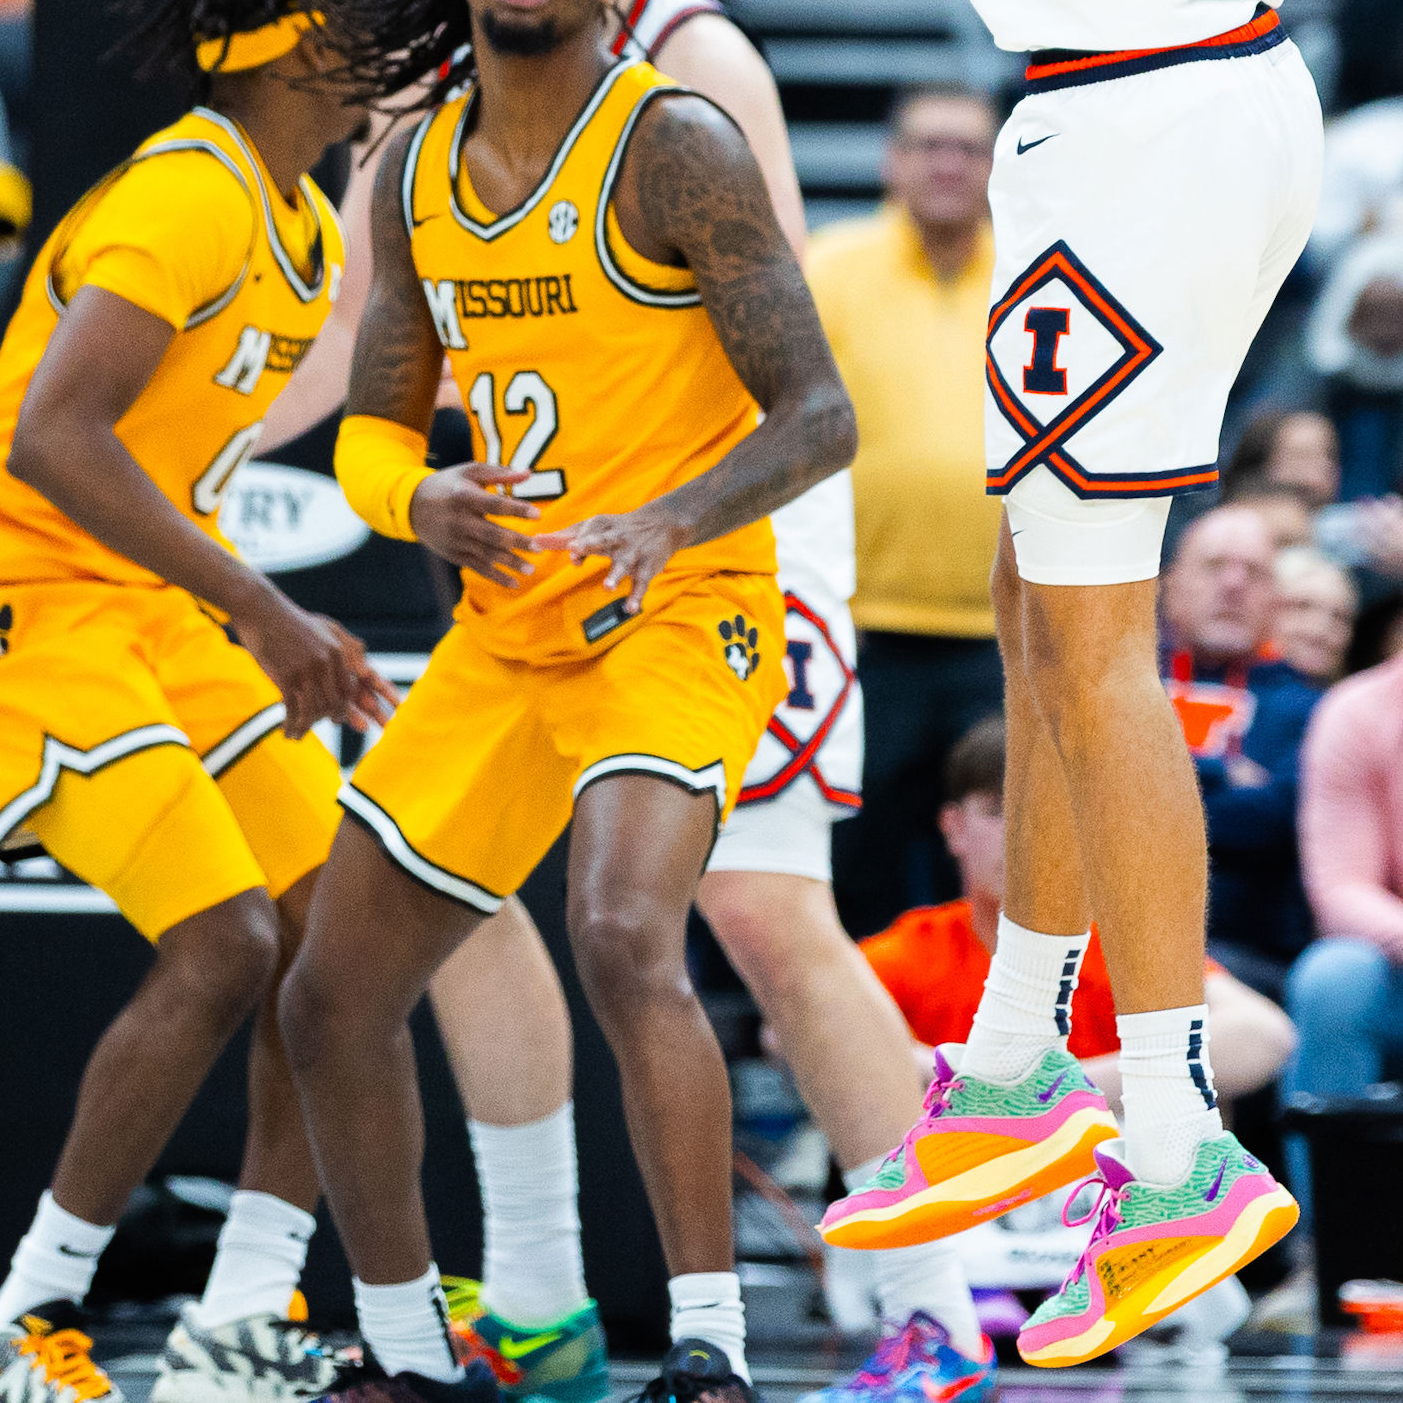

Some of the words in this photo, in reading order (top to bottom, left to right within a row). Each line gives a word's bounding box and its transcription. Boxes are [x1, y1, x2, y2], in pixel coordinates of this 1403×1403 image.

[421, 273, 578, 350] MISSOURI
[1023, 306, 1070, 395] I
[469, 371, 568, 502] 12
